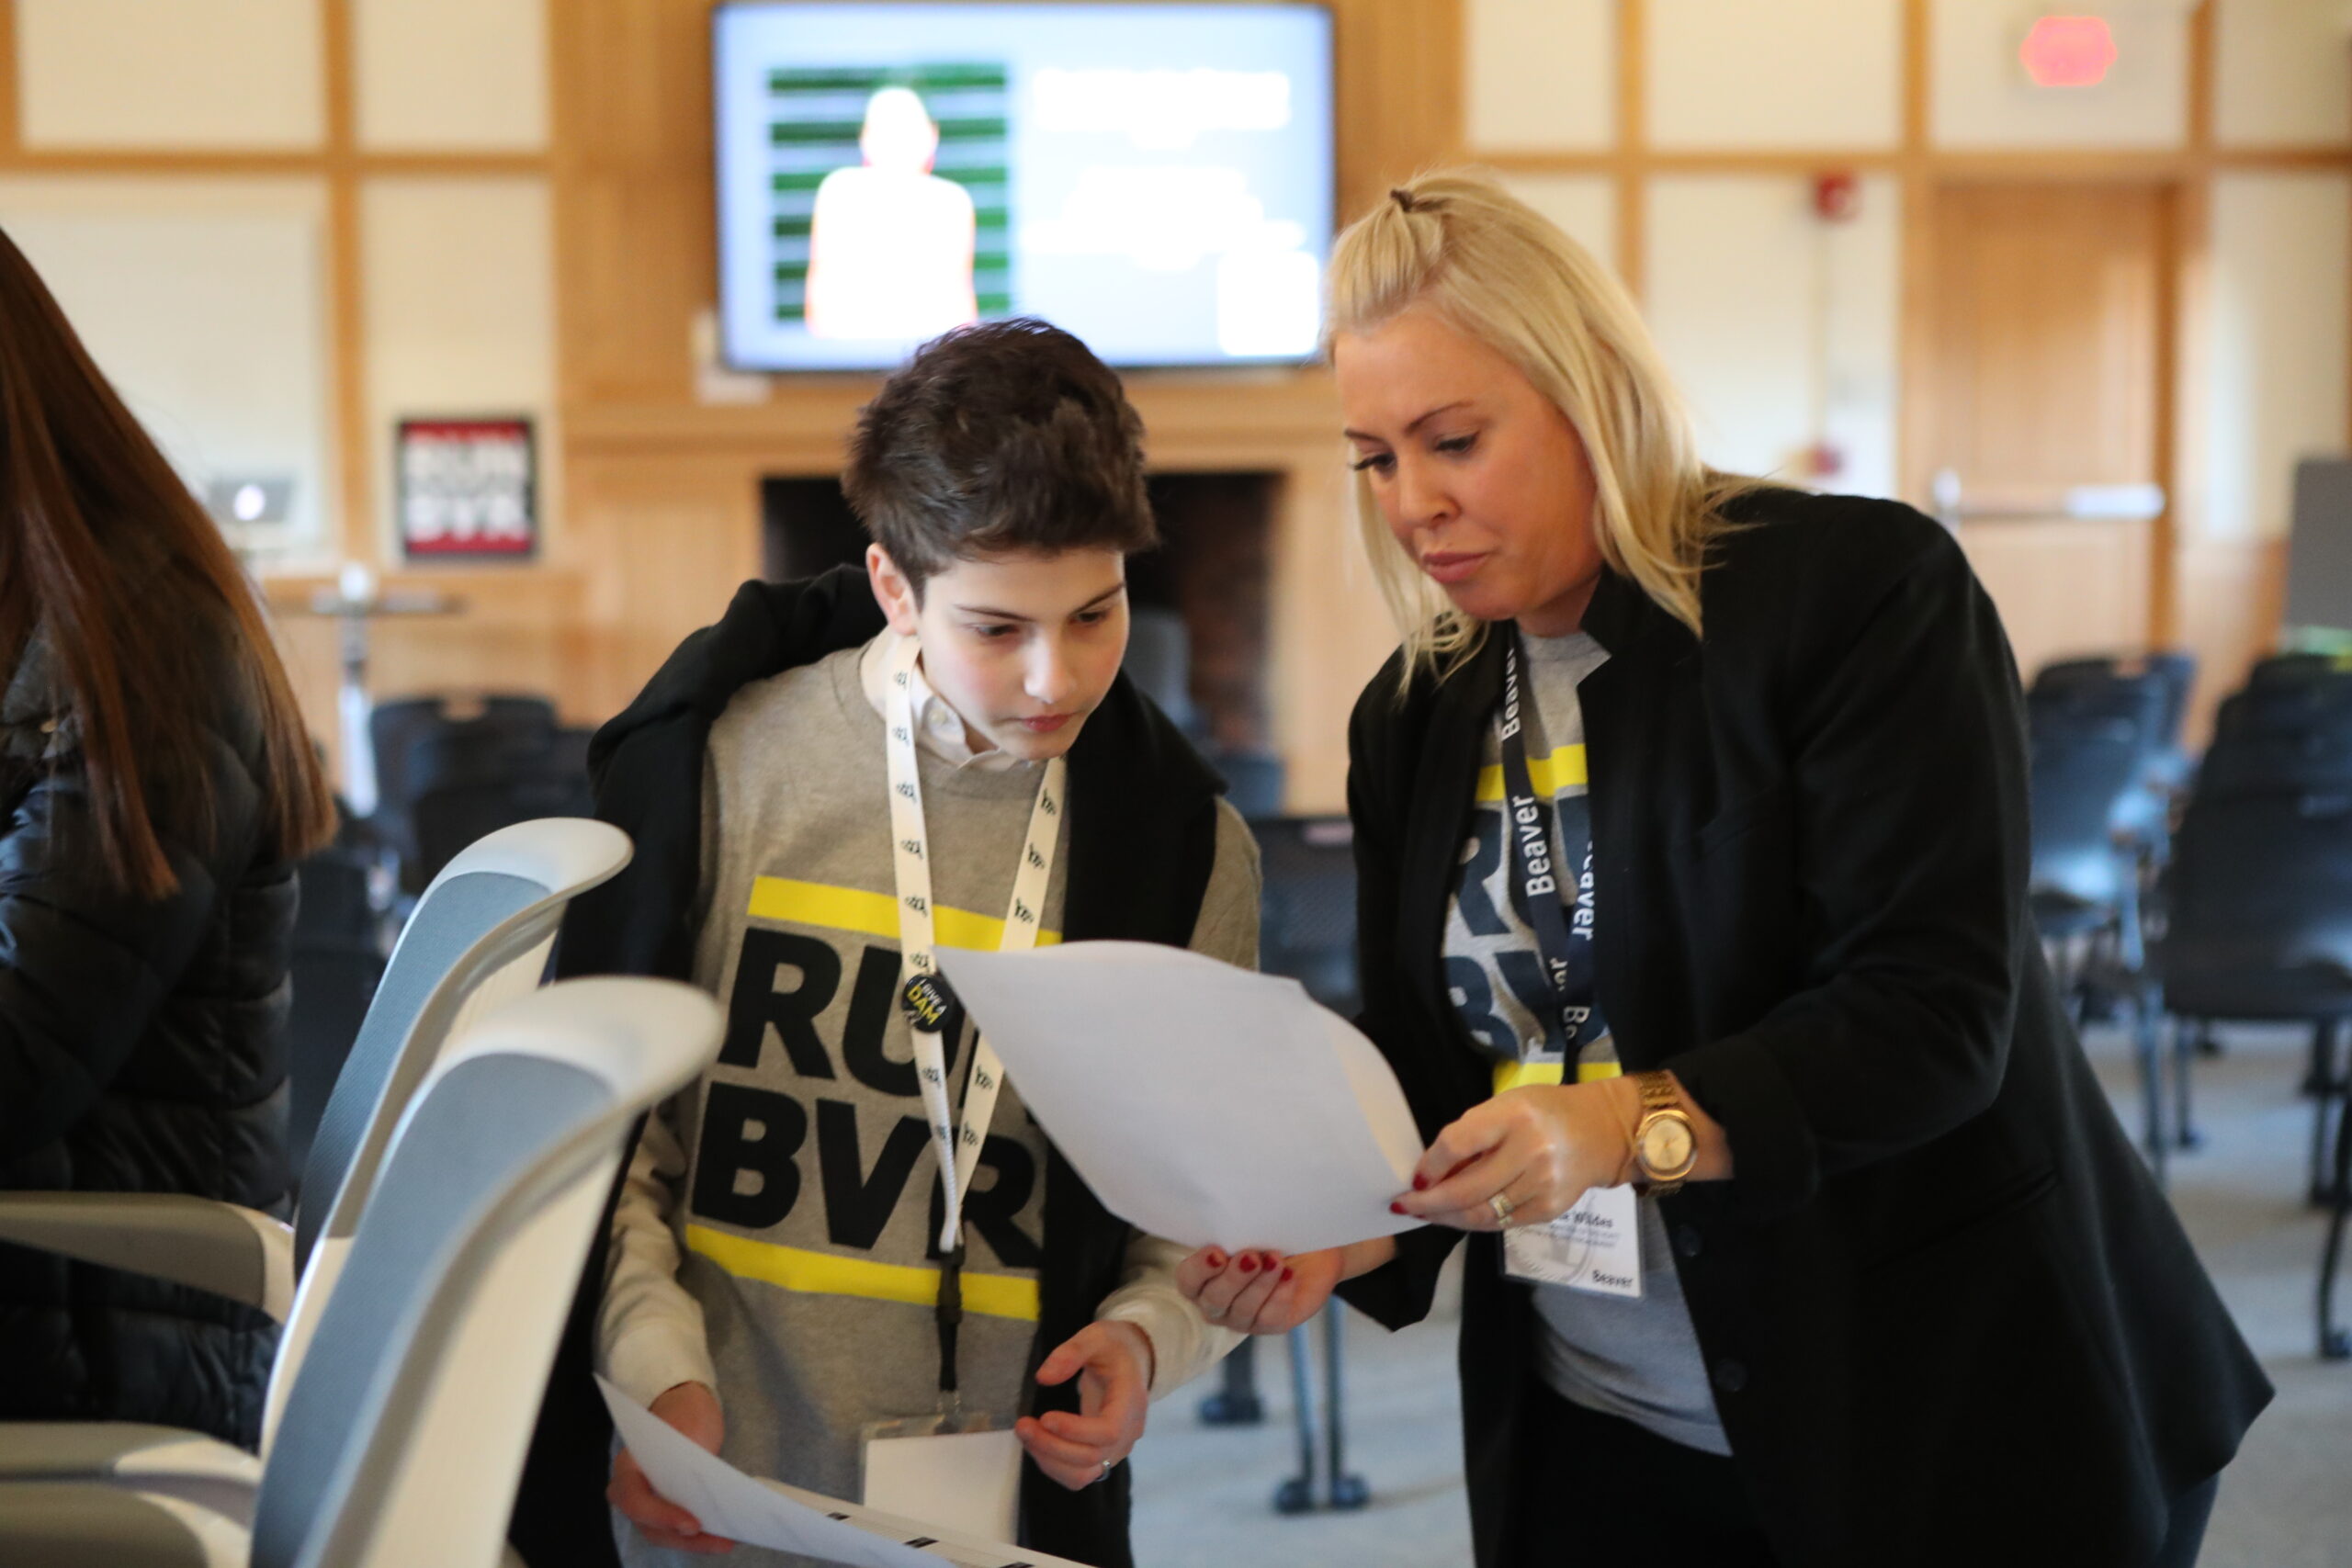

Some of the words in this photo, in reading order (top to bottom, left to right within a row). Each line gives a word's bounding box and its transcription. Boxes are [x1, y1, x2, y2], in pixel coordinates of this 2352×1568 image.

[1511, 795, 1556, 897] Beaver
[1571, 840, 1595, 942] eaver
[718, 927, 1034, 1124] RU
[907, 985, 942, 1025] DAM
[691, 1081, 1044, 1269] BVR
